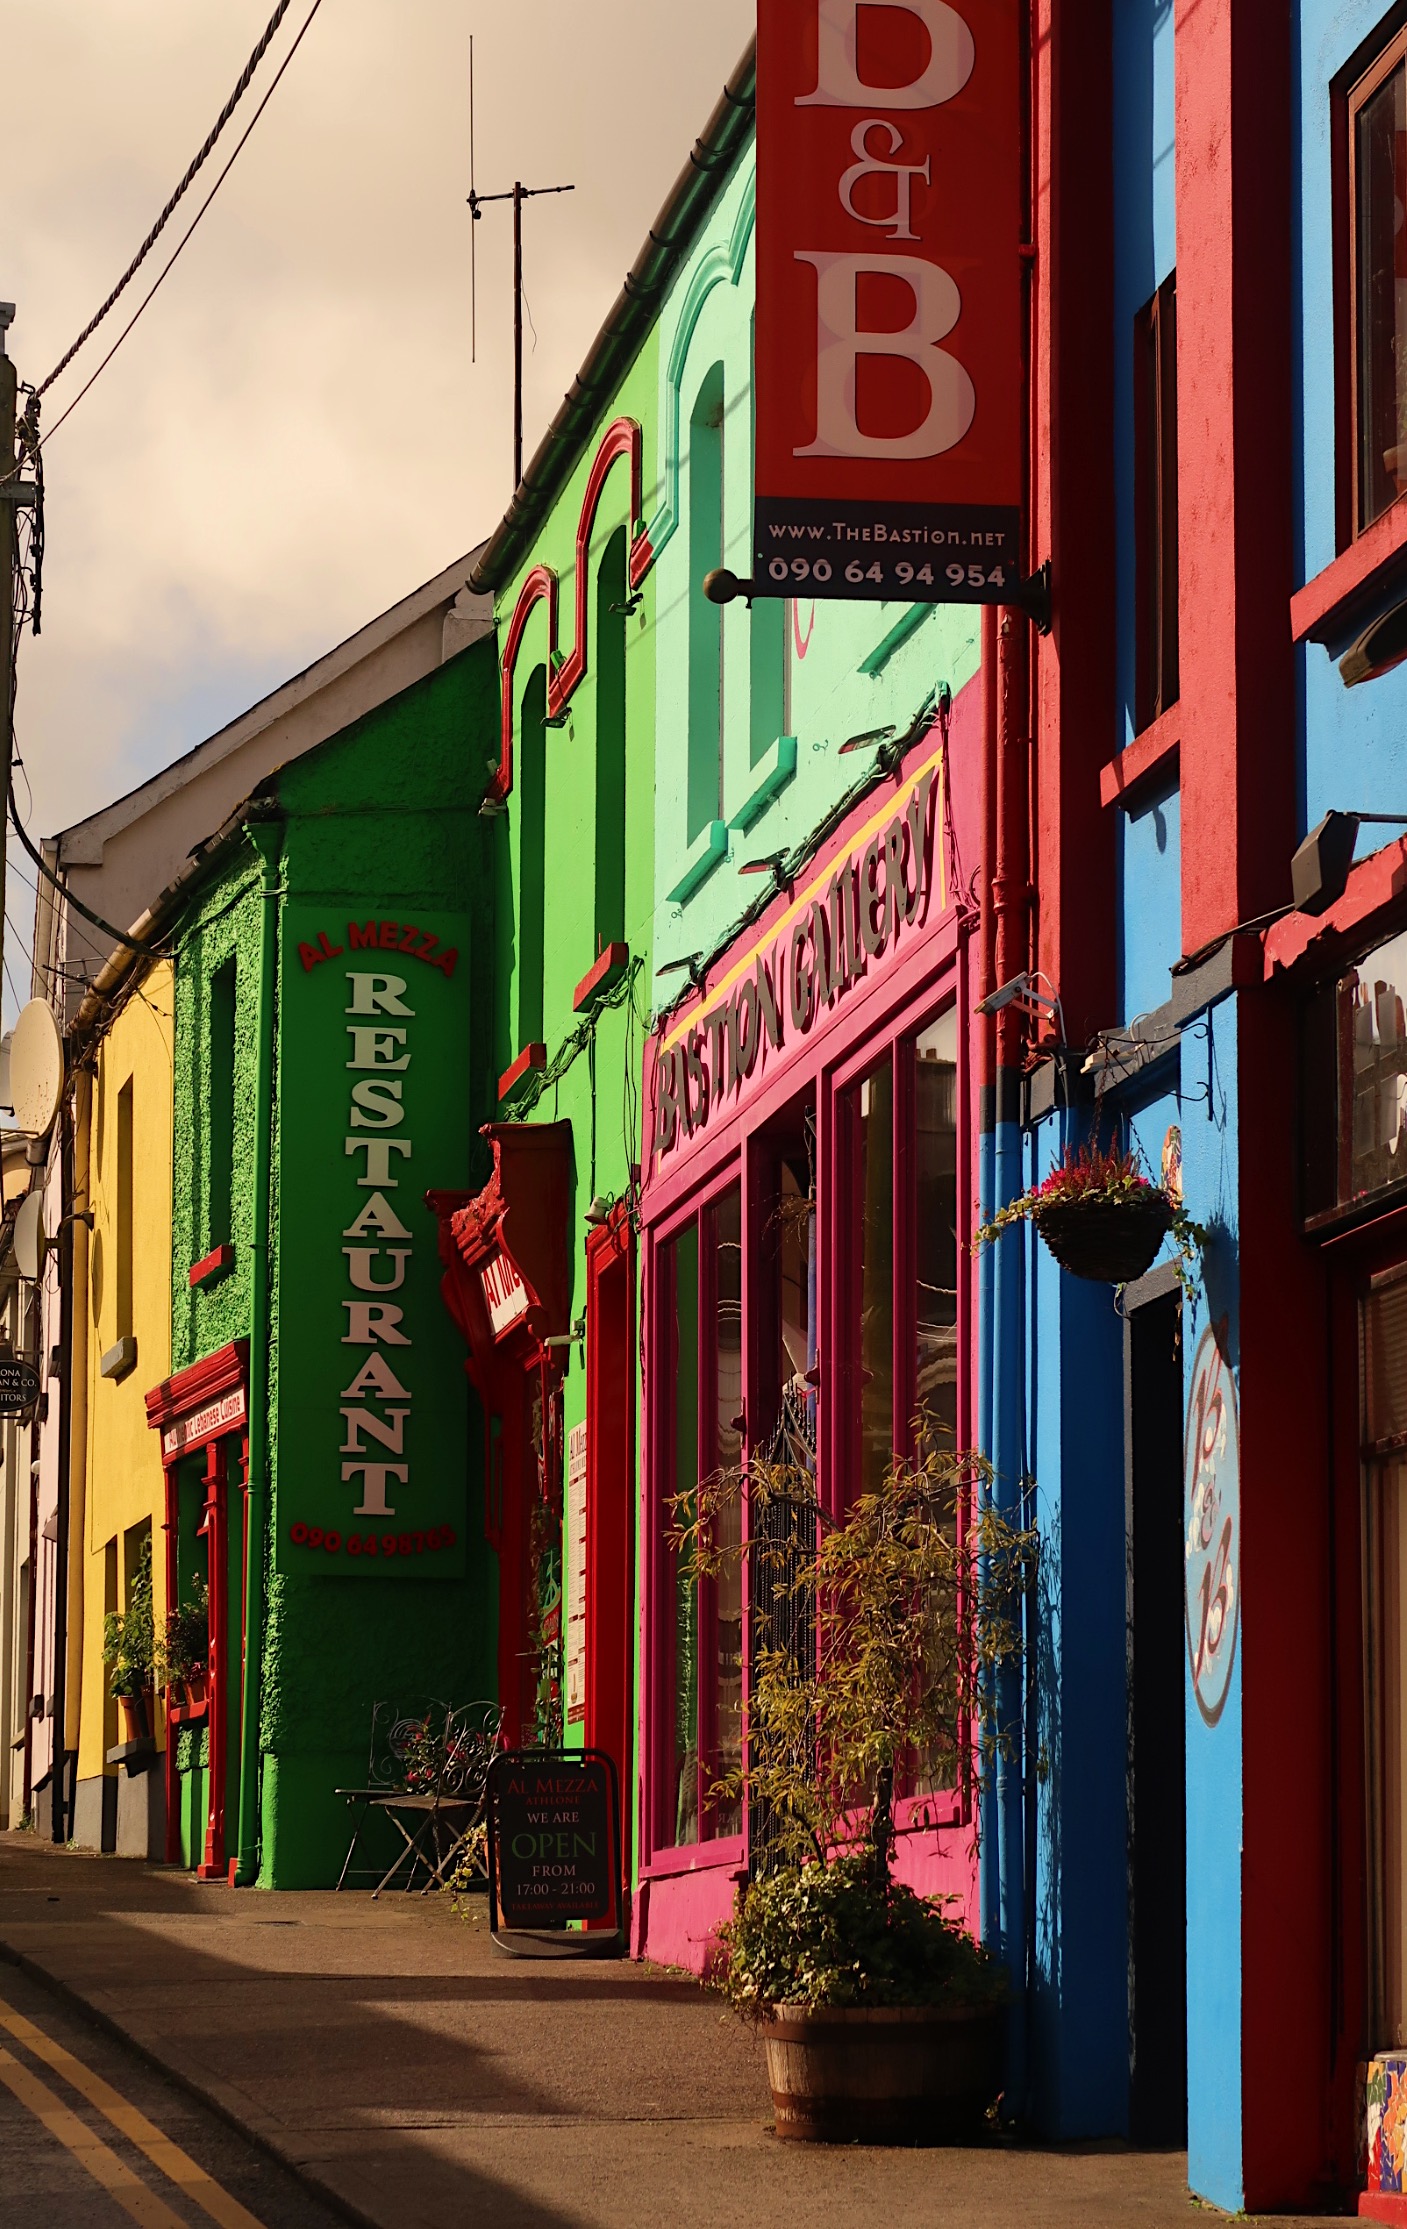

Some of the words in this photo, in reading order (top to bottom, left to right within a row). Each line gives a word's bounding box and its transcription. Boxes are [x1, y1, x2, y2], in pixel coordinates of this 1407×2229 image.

[838, 118, 931, 241] &
[793, 250, 976, 460] B
[768, 556, 832, 582] 090
[844, 559, 883, 583] 64
[894, 561, 934, 585] 94
[945, 562, 1006, 587] 954
[297, 931, 343, 973] AL
[348, 919, 459, 978] MEZZA
[651, 939, 779, 1156] BASTION
[790, 768, 936, 1030] GALLERY
[339, 971, 416, 1516] RESTAURANT
[0, 1368, 21, 1377] ONA
[20, 1378, 37, 1387] CO.
[0, 1393, 27, 1402] ITORS
[290, 1522, 341, 1553] 090
[507, 1779, 529, 1794] AL
[536, 1777, 599, 1793] MEZZA
[525, 1795, 581, 1806] ATHLONE
[527, 1812, 548, 1824] WE
[552, 1811, 580, 1823] ARE
[511, 1831, 597, 1859] OPEN
[532, 1864, 576, 1877] FROM
[516, 1883, 549, 1896] 17:00
[560, 1882, 595, 1895] 21:00
[511, 1902, 552, 1912] TAKEAWAY
[557, 1900, 600, 1911] AVAILABLE
